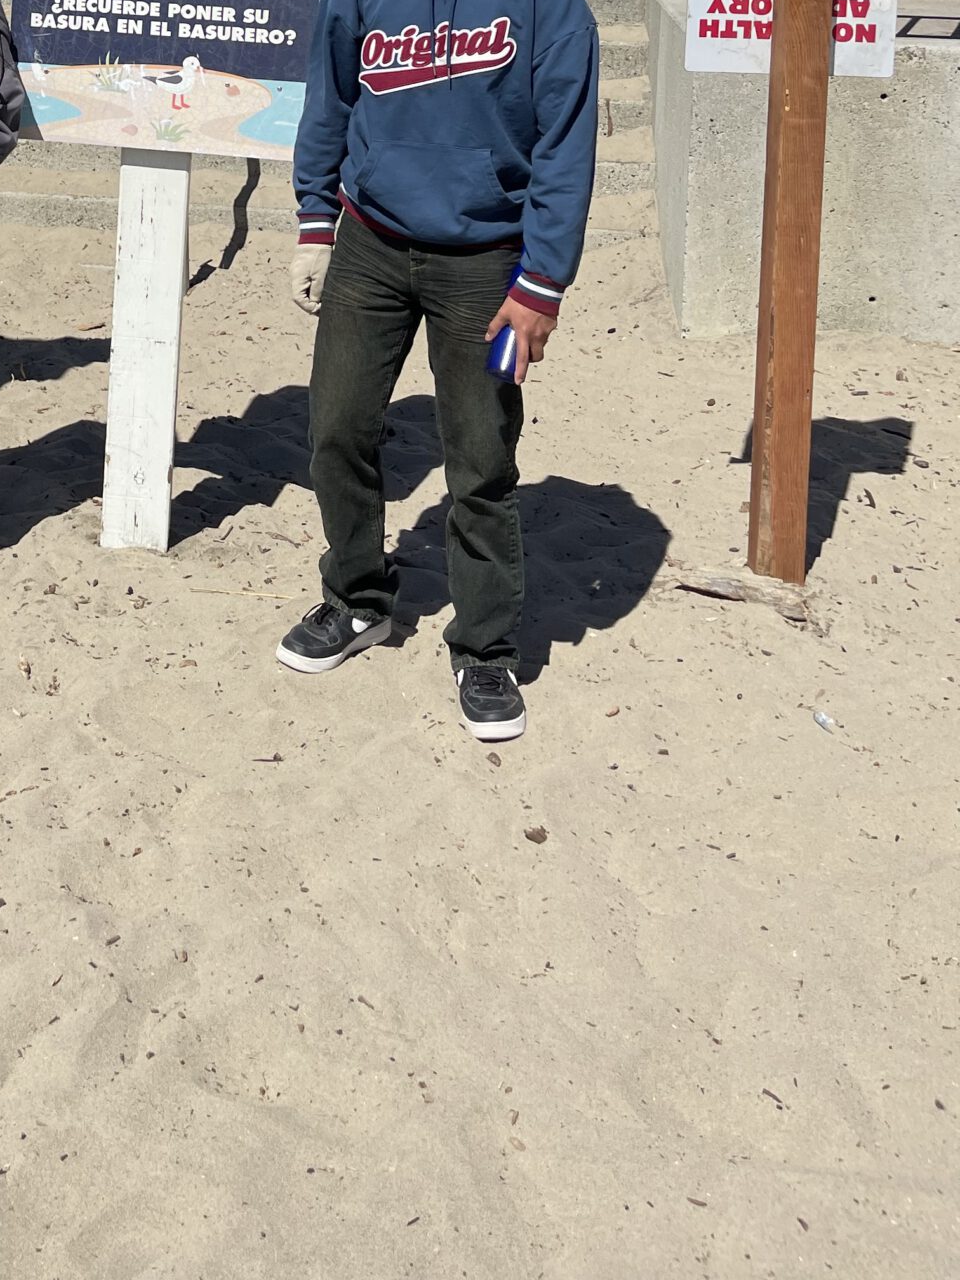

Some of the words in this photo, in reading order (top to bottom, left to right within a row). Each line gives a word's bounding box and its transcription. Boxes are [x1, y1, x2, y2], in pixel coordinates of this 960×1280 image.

[168, 3, 236, 23] PONER
[243, 8, 270, 25] SU
[30, 13, 110, 33] BASURA
[116, 18, 143, 35] EN
[150, 20, 172, 37] EL
[178, 23, 297, 46] BASURERO?
[698, 19, 773, 40] ALTH
[832, 23, 877, 43] NO
[360, 16, 511, 69] Original
